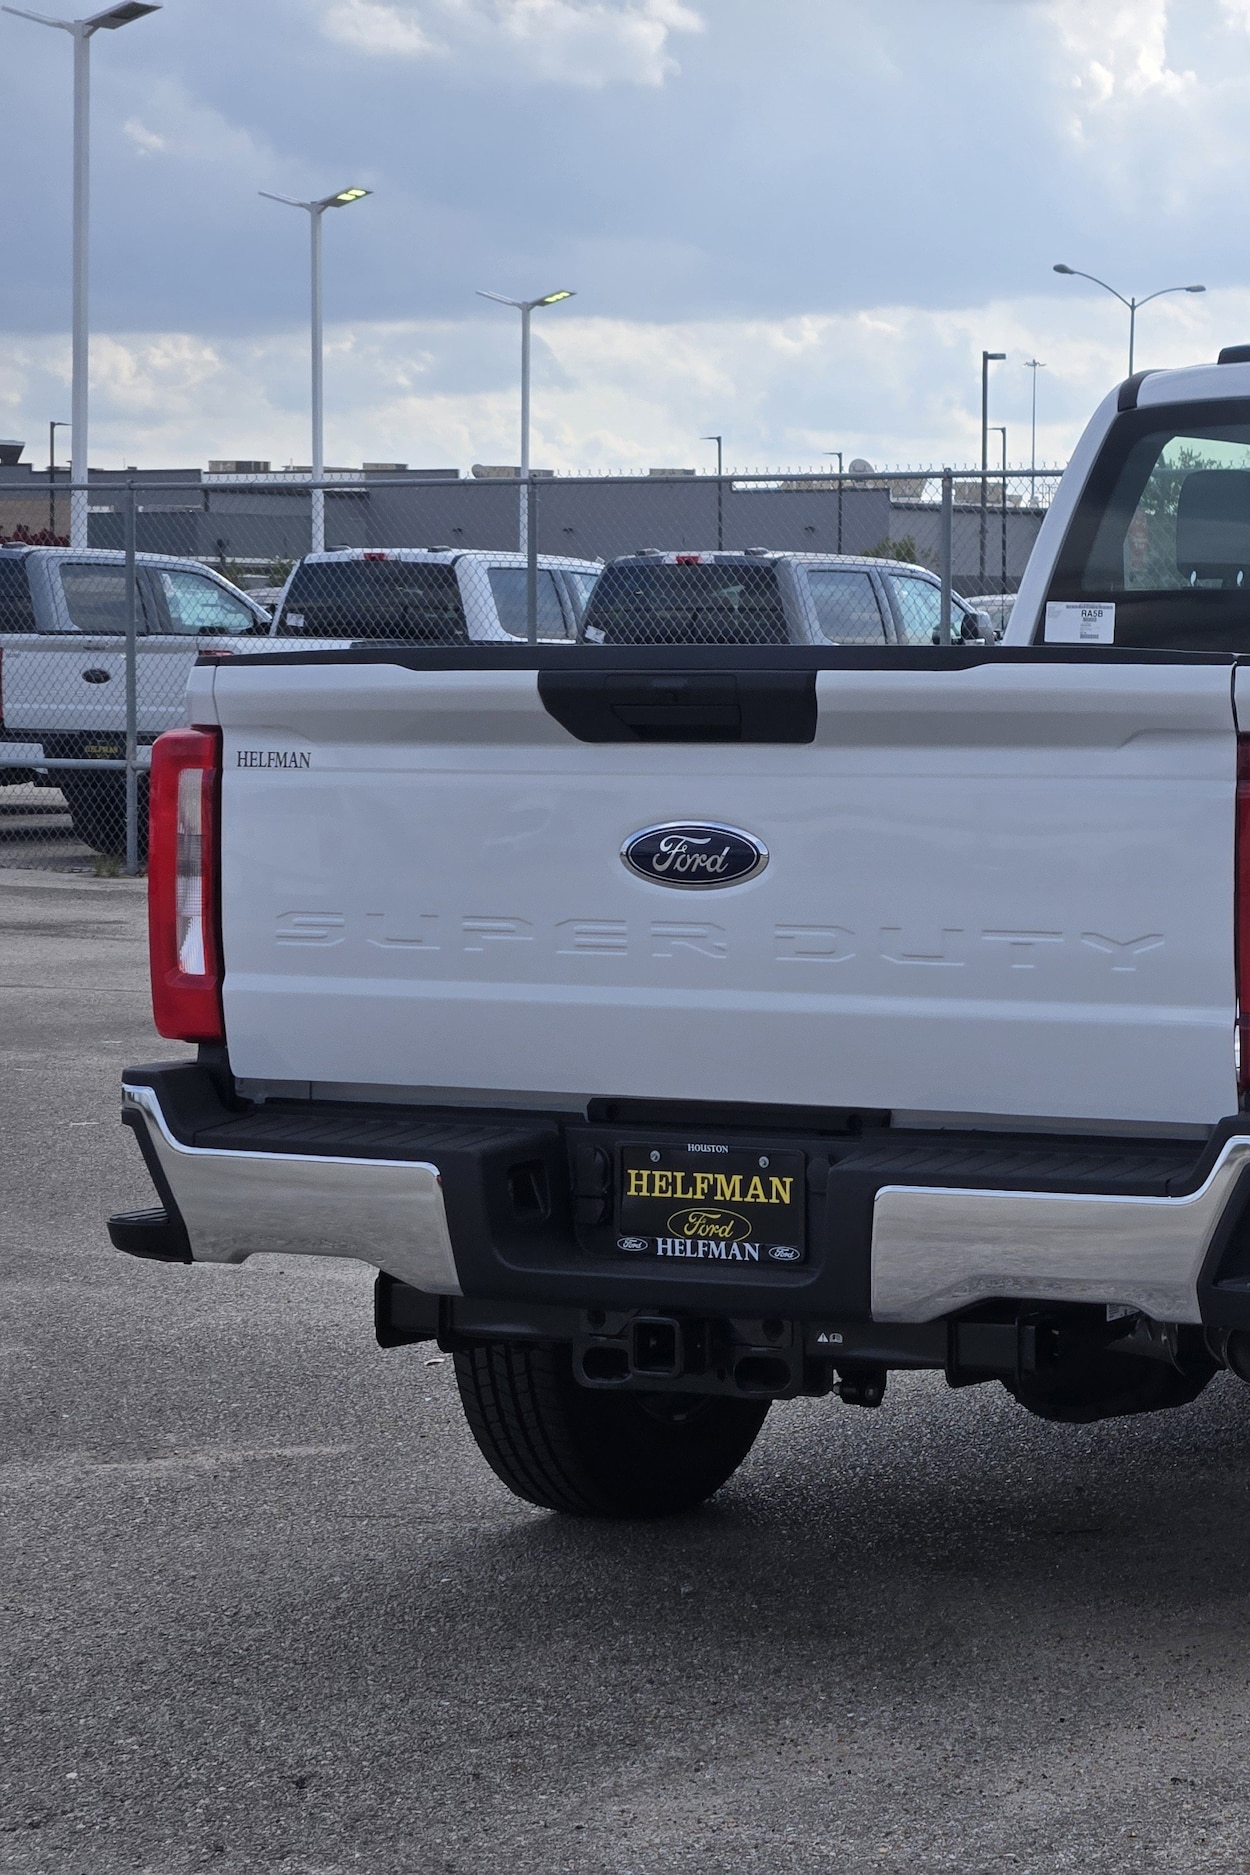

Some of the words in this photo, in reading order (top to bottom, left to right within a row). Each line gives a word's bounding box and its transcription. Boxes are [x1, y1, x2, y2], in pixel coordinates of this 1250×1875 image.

[236, 750, 312, 769] HELFMAN
[652, 834, 731, 873] Ford
[276, 911, 727, 959] SUPER
[774, 923, 1165, 972] DUTY
[687, 1143, 729, 1154] HOUSTON
[626, 1169, 794, 1205] HELFMAN
[683, 1211, 735, 1238] Ford
[656, 1237, 761, 1262] HELFMAN
